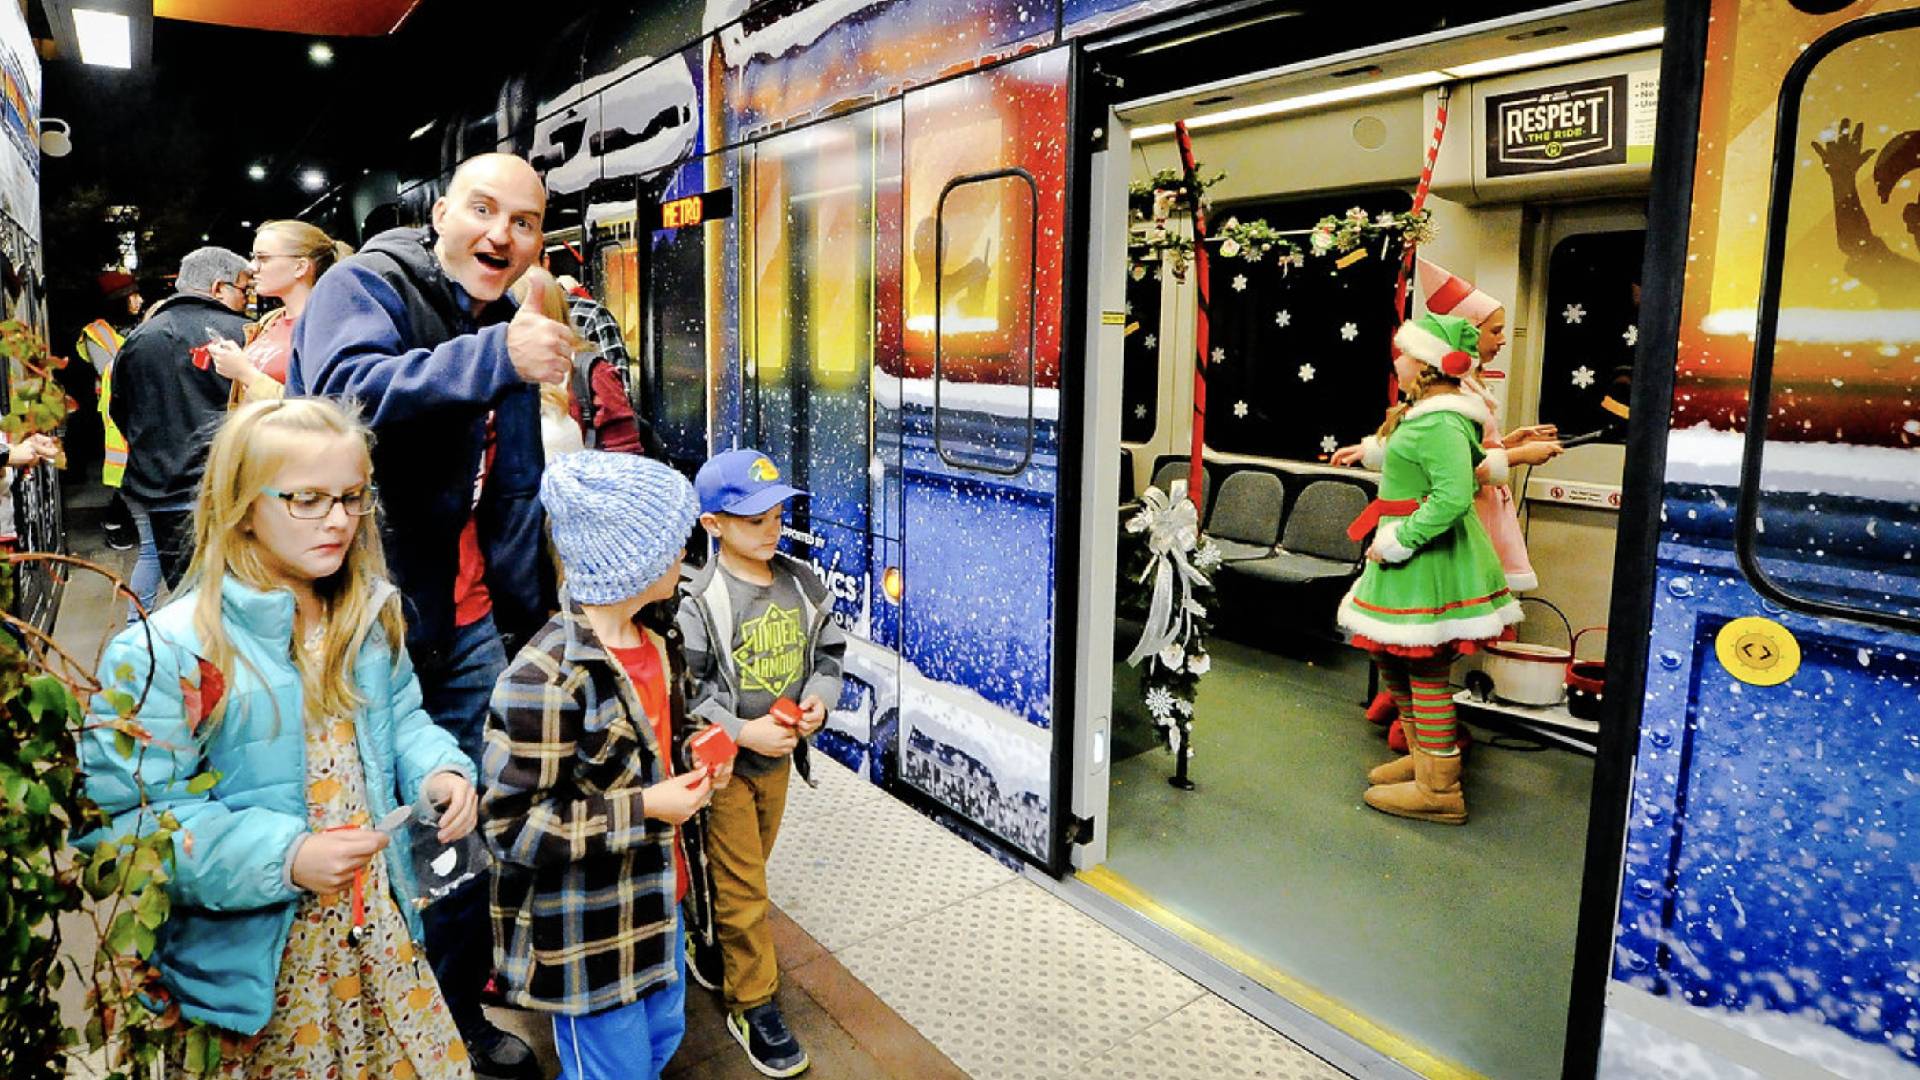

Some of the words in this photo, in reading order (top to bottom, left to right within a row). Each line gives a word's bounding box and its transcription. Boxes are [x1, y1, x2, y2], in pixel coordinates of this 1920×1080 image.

[1507, 97, 1604, 146] RESPECT
[1528, 131, 1550, 143] THE
[1554, 127, 1584, 139] RIDE
[662, 196, 702, 229] METRO
[754, 619, 798, 653] UNDER
